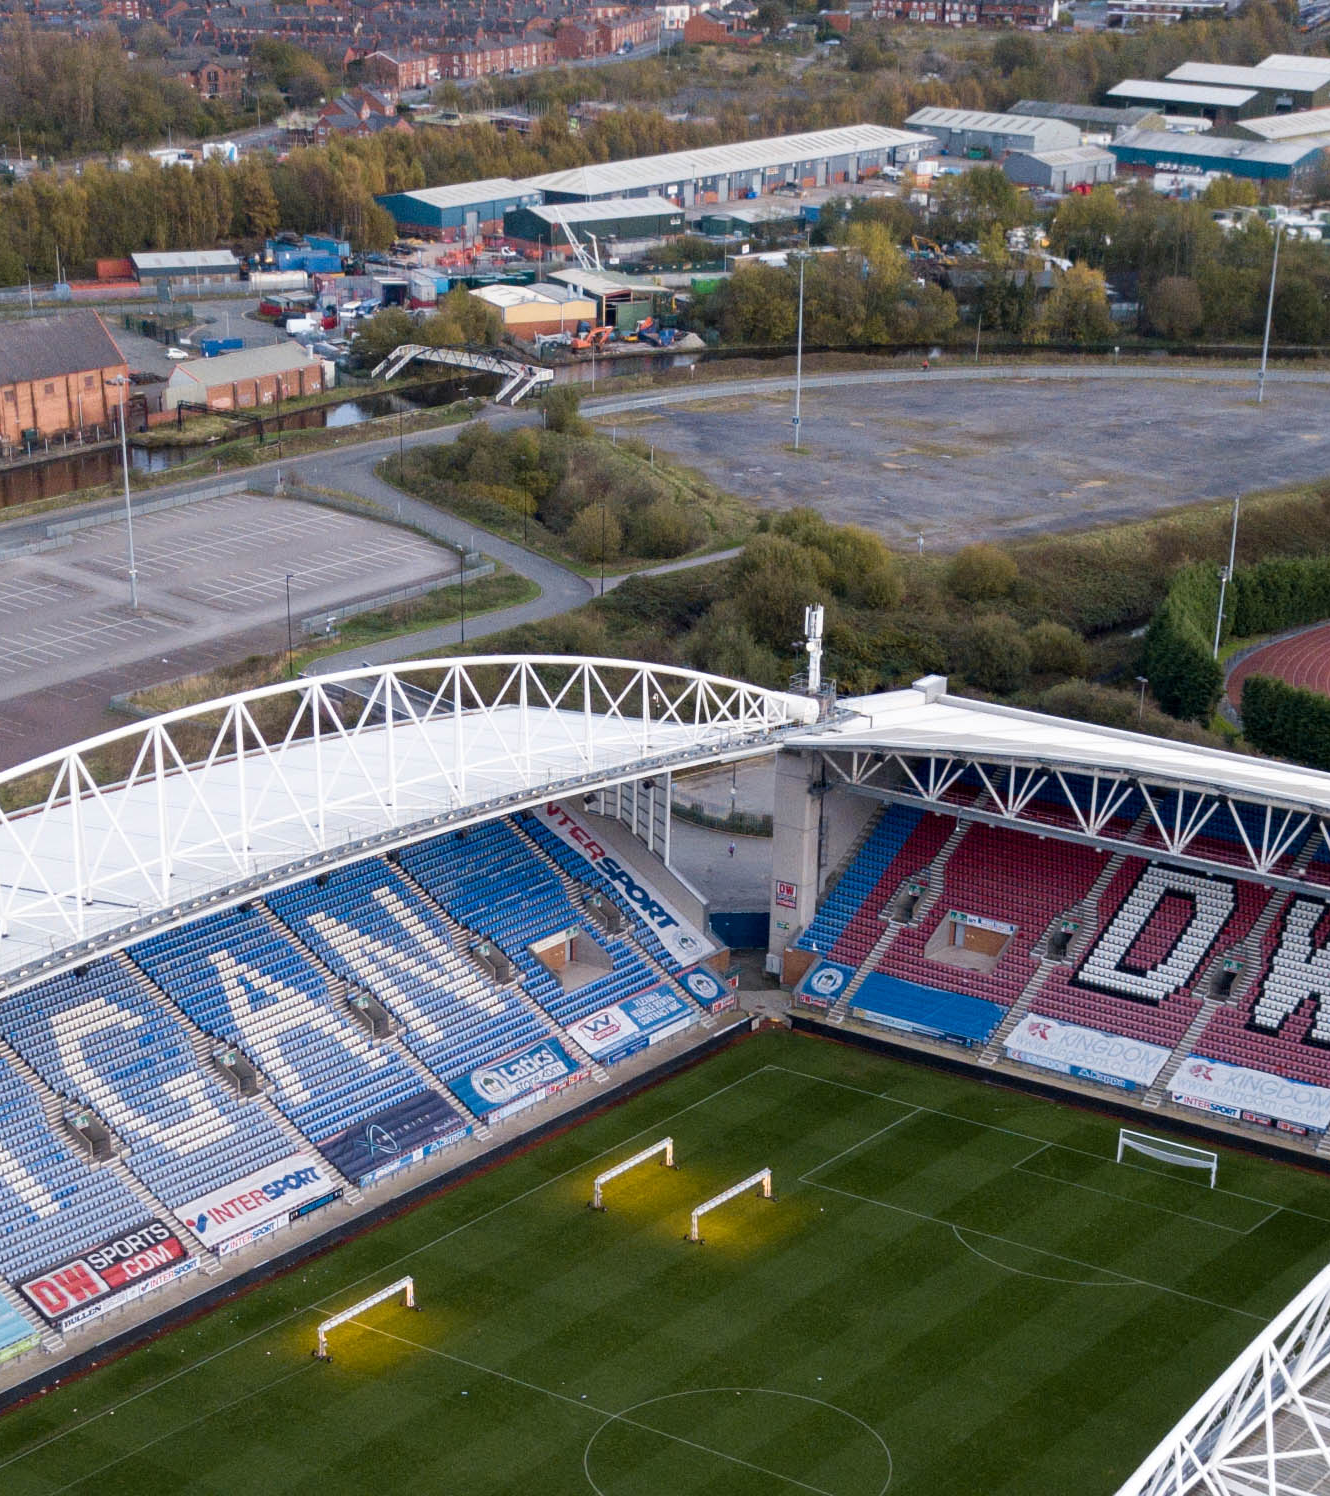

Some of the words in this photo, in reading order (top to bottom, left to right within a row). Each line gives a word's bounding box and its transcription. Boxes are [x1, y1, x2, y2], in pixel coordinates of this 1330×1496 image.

[499, 1049, 556, 1082] Latics
[1060, 1031, 1162, 1067] KINGDOM
[1183, 1095, 1238, 1116] INTERSPORT
[207, 1166, 321, 1225] INTERSPORT
[88, 1222, 170, 1270] SPORTS
[230, 1221, 277, 1250] INTERSPORT
[123, 1245, 173, 1281] .COM
[150, 1258, 199, 1288] INTERSPORT
[29, 1263, 100, 1314] DW
